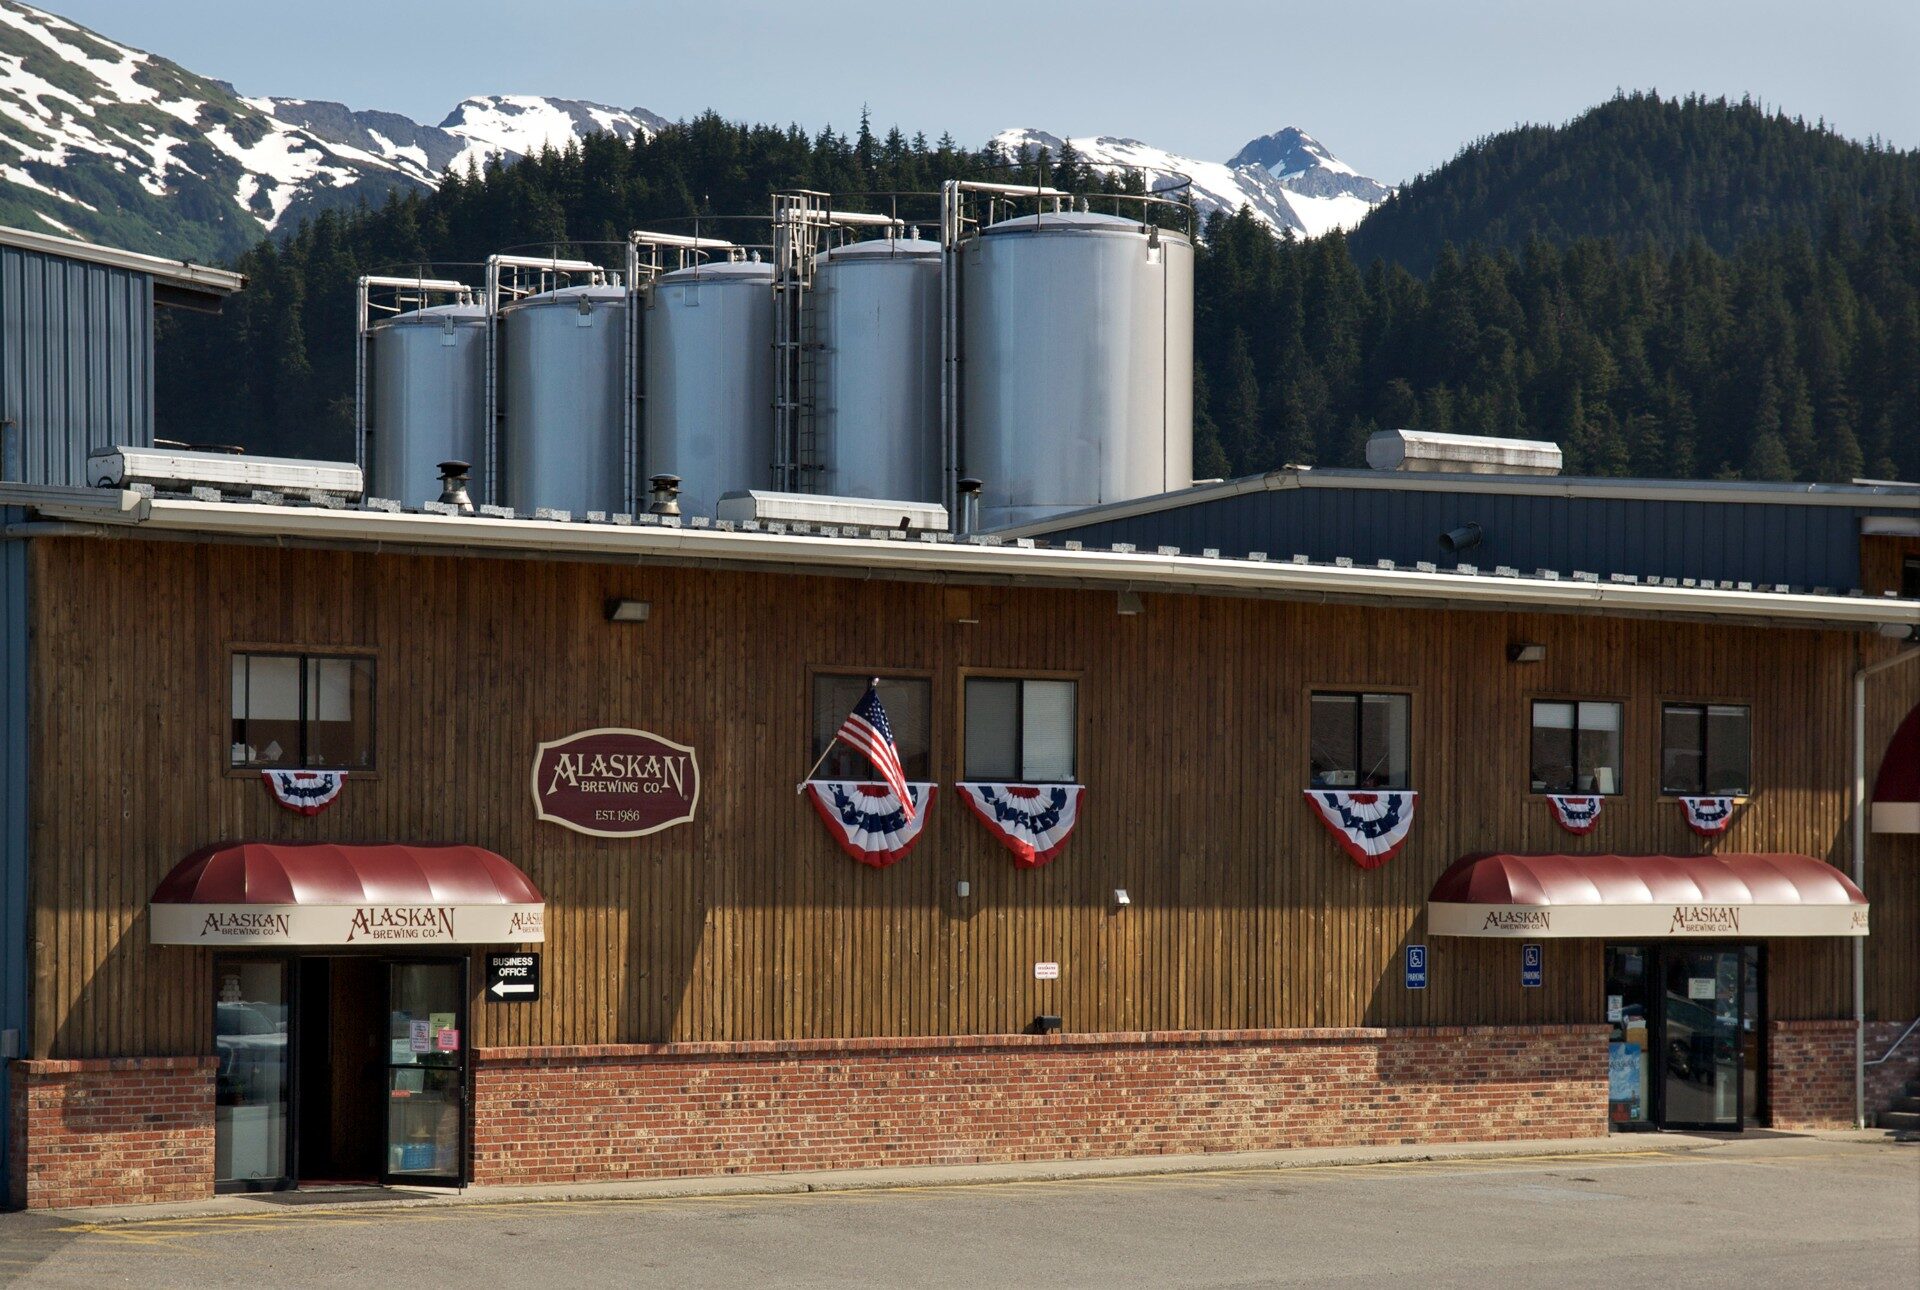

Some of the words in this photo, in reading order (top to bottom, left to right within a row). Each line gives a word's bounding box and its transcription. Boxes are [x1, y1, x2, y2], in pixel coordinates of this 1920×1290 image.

[546, 753, 686, 797] ALASKAN
[581, 779, 638, 793] BREWING
[643, 782, 663, 793] CO.
[595, 810, 615, 821] EST.
[617, 808, 640, 822] 1986
[200, 912, 290, 937] ALASKAN
[346, 907, 456, 942] ALASKAN
[1482, 911, 1551, 930] ALASKAN
[1669, 906, 1739, 933] ALASKAN
[222, 927, 260, 935] BREWING
[373, 928, 418, 939] BREWING
[422, 929, 438, 938] CO.
[1686, 924, 1715, 932] BREWING
[492, 957, 533, 967] BUSINESS
[499, 967, 527, 977] OFFICE
[1407, 972, 1425, 981] PARKING
[1524, 971, 1540, 980] PARKING
